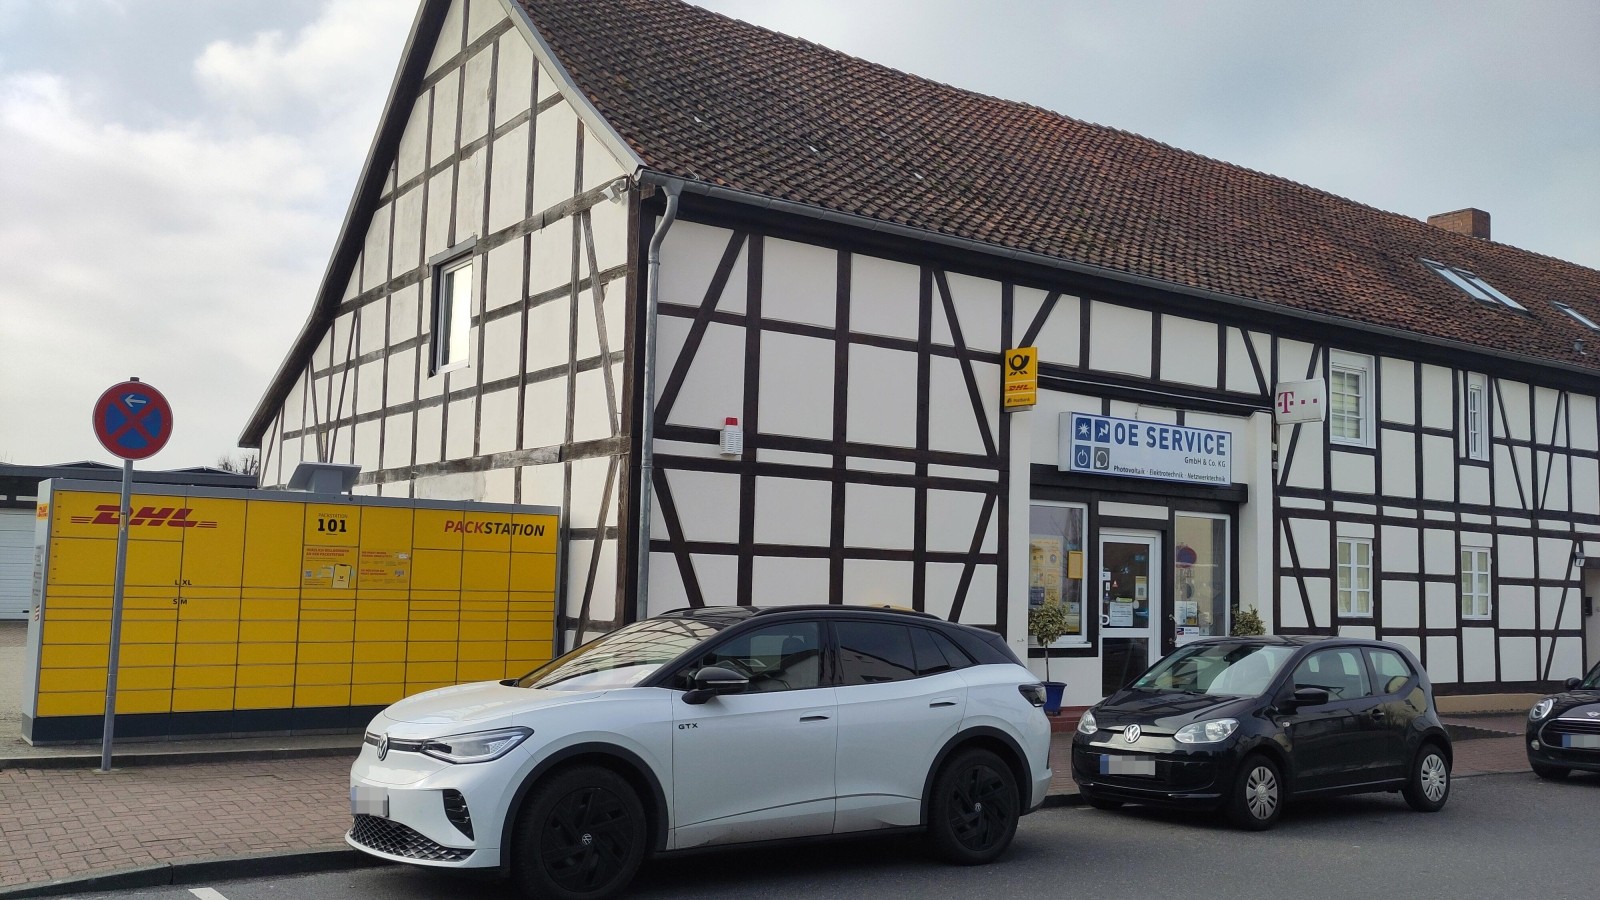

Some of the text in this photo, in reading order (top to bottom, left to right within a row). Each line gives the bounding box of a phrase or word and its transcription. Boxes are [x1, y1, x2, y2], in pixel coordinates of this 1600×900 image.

[1114, 423, 1226, 456] OE SERVICE
[1184, 456, 1202, 466] GmbH
[1208, 459, 1217, 467] Co.
[1218, 460, 1226, 468] KG
[1113, 465, 1226, 482] Photovoltaik Elektrotechnik Netzwerktechnik
[91, 504, 198, 528] DHL
[317, 519, 347, 533] 101
[444, 520, 545, 537] PACKSTATION
